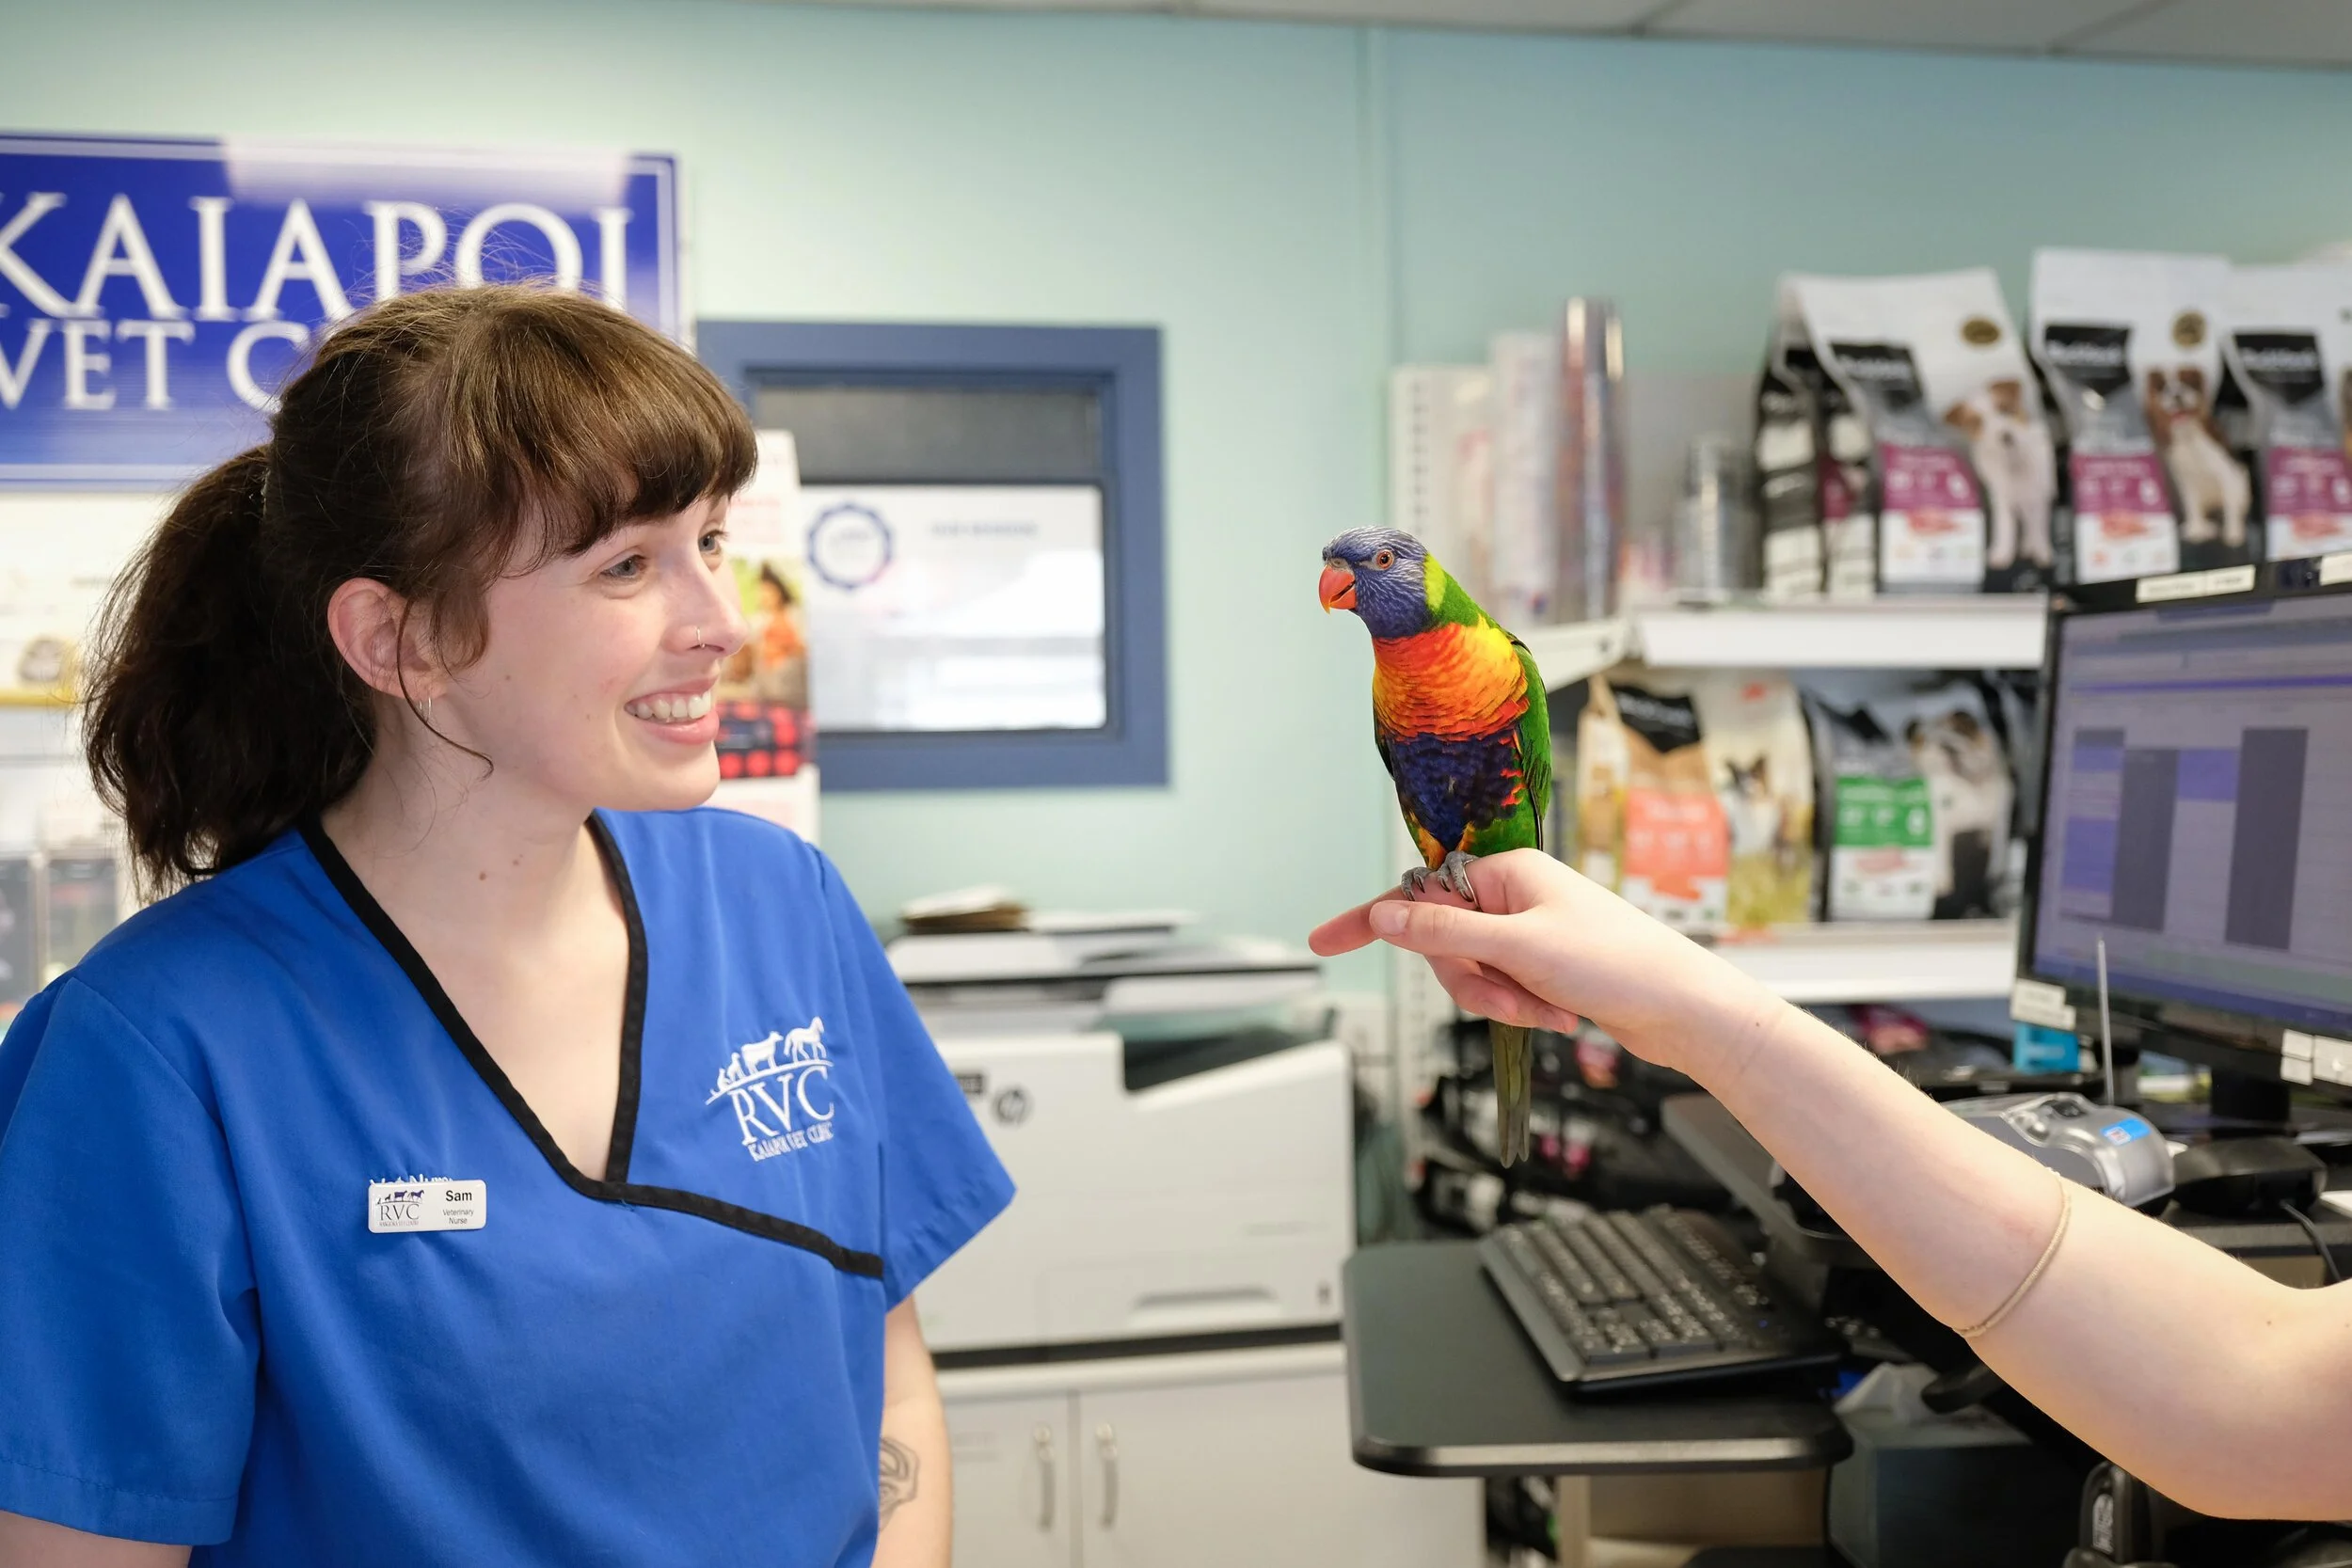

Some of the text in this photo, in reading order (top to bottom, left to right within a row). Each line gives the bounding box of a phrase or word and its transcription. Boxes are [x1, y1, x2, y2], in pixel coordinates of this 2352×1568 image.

[0, 191, 634, 321] KAIAPOI
[0, 318, 196, 410] VET
[727, 1065, 834, 1147] RVC
[380, 1203, 420, 1221] RVC
[442, 1209, 474, 1217] Veterinary
[445, 1190, 472, 1202] Sam
